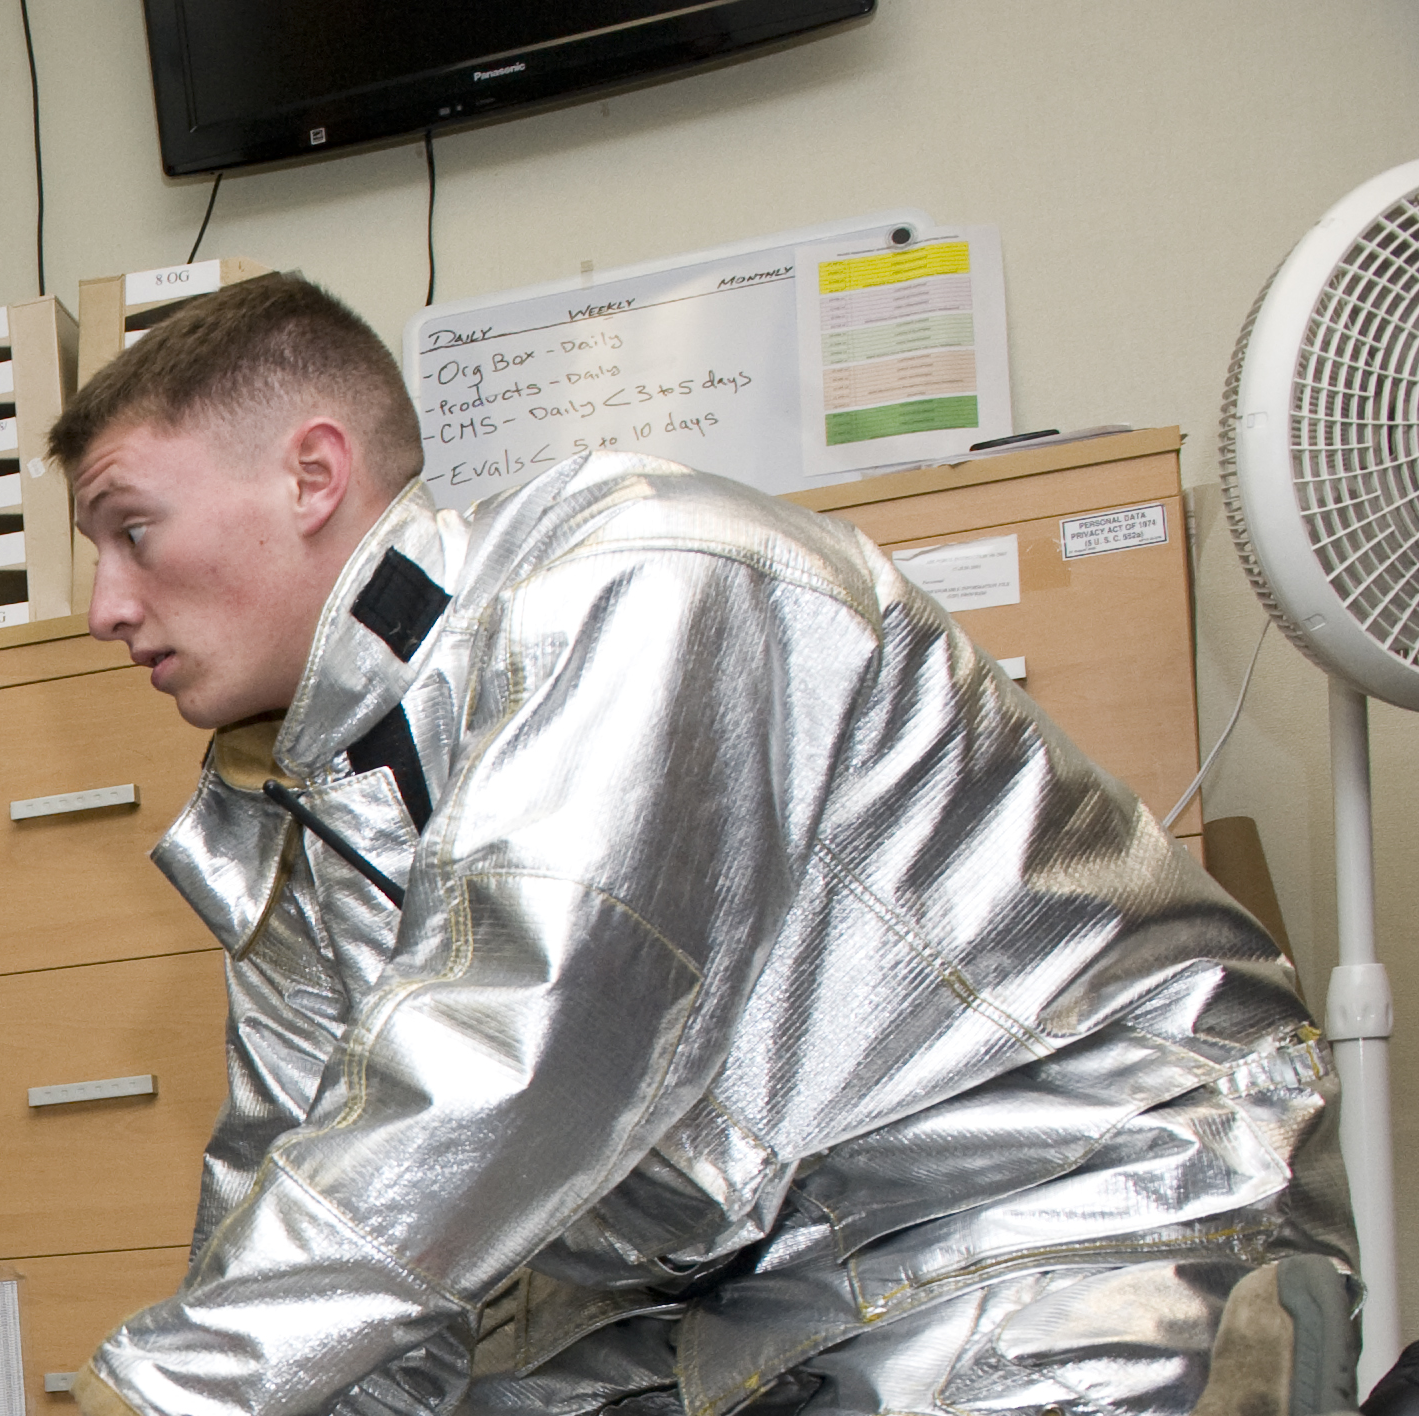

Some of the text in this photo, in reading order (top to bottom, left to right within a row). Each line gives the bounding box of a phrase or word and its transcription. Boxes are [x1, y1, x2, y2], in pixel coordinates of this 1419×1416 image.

[474, 62, 525, 81] Panasonic
[155, 270, 189, 286] 8 OG
[717, 266, 793, 289] MONTHLY
[568, 298, 635, 322] WEEKLY
[427, 326, 493, 346] DAILY
[492, 351, 535, 372] Box
[560, 332, 623, 353] Daily
[566, 365, 621, 384] Daily
[529, 400, 595, 420] Daily
[635, 386, 653, 402] 3
[657, 385, 673, 397] to
[679, 380, 694, 395] 5
[702, 370, 752, 394] days
[571, 438, 589, 455] 5
[599, 436, 617, 448] to
[633, 422, 651, 440] 10
[665, 412, 719, 437] days
[1071, 528, 1105, 540] PRIVACY
[1107, 524, 1123, 534] ACT
[1125, 522, 1137, 530] OF
[1079, 512, 1147, 530] PERSONAL DATA
